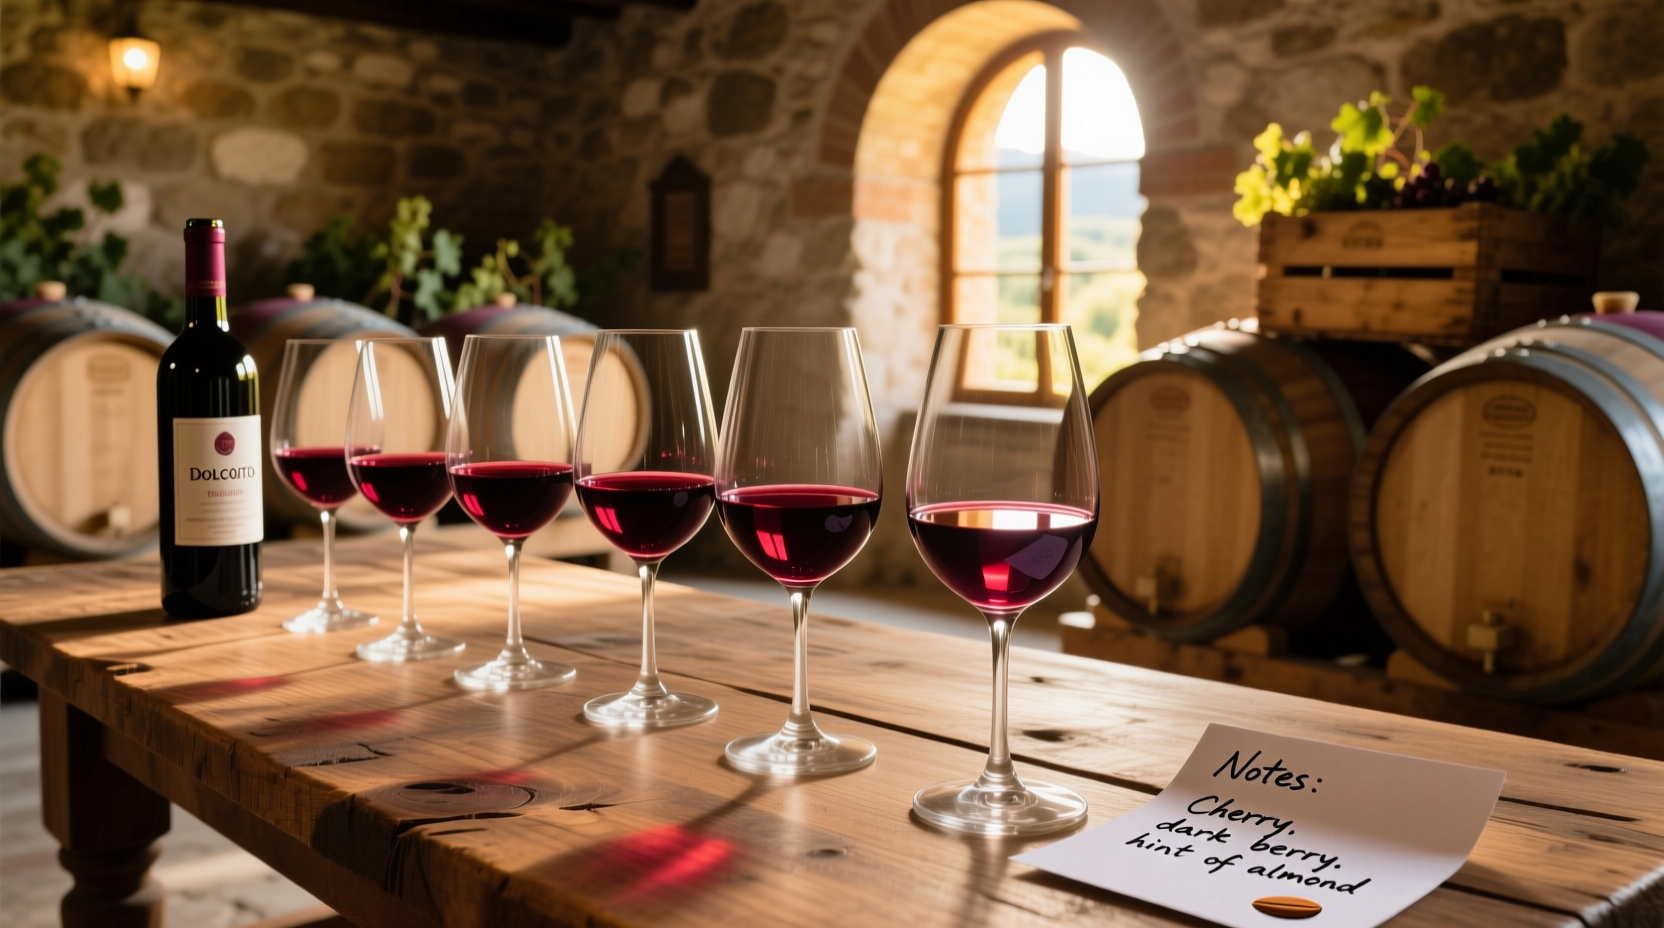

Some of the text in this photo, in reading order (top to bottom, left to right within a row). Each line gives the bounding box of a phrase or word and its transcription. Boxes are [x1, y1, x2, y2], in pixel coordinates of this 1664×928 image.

[1212, 750, 1323, 794] Notes:
[1156, 818, 1232, 844] dark
[1125, 832, 1372, 895] hint of almond
